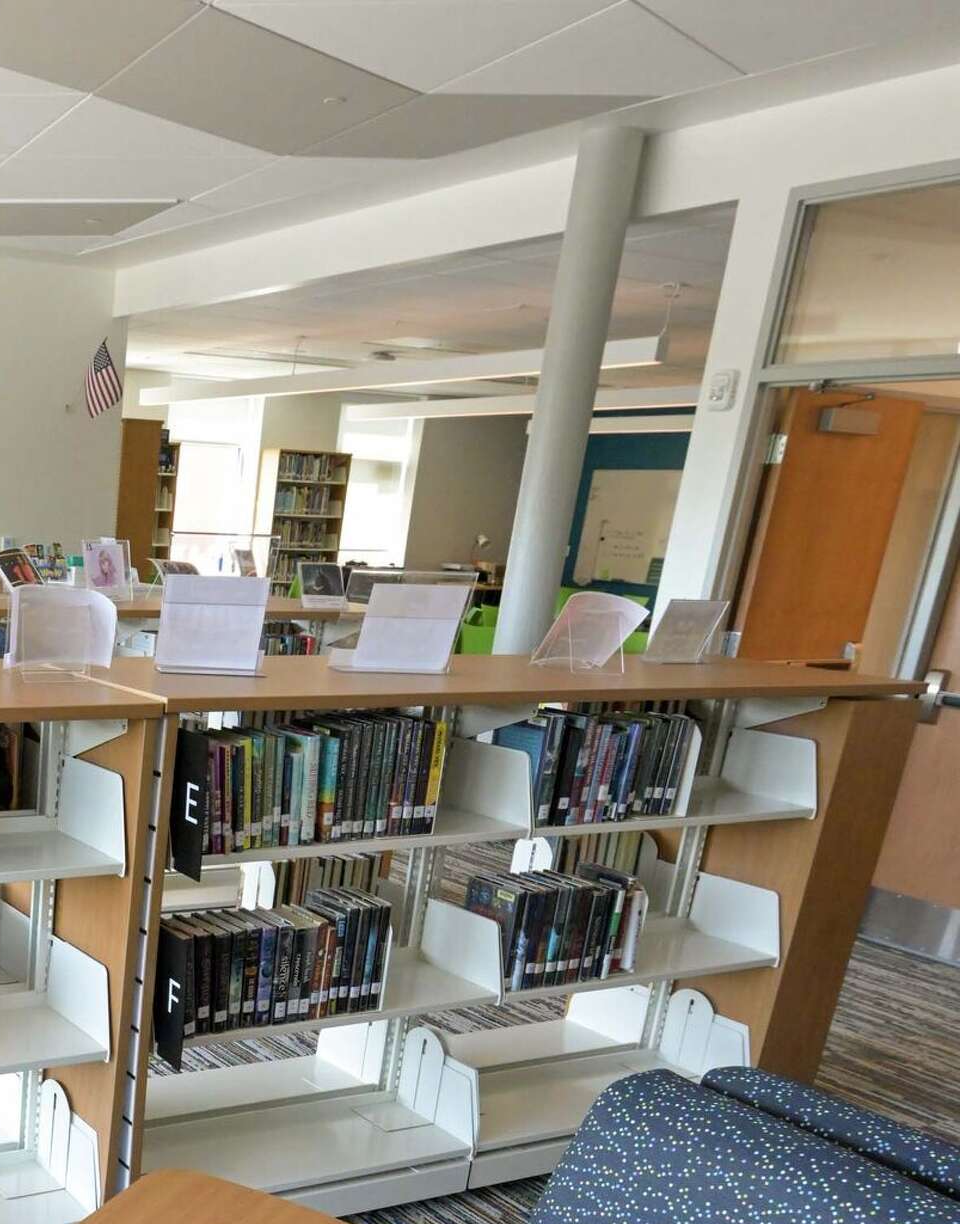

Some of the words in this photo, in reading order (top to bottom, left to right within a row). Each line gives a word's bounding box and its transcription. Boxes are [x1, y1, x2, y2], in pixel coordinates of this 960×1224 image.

[185, 782, 200, 825] E
[278, 956, 288, 992] silence
[167, 977, 181, 1013] F
